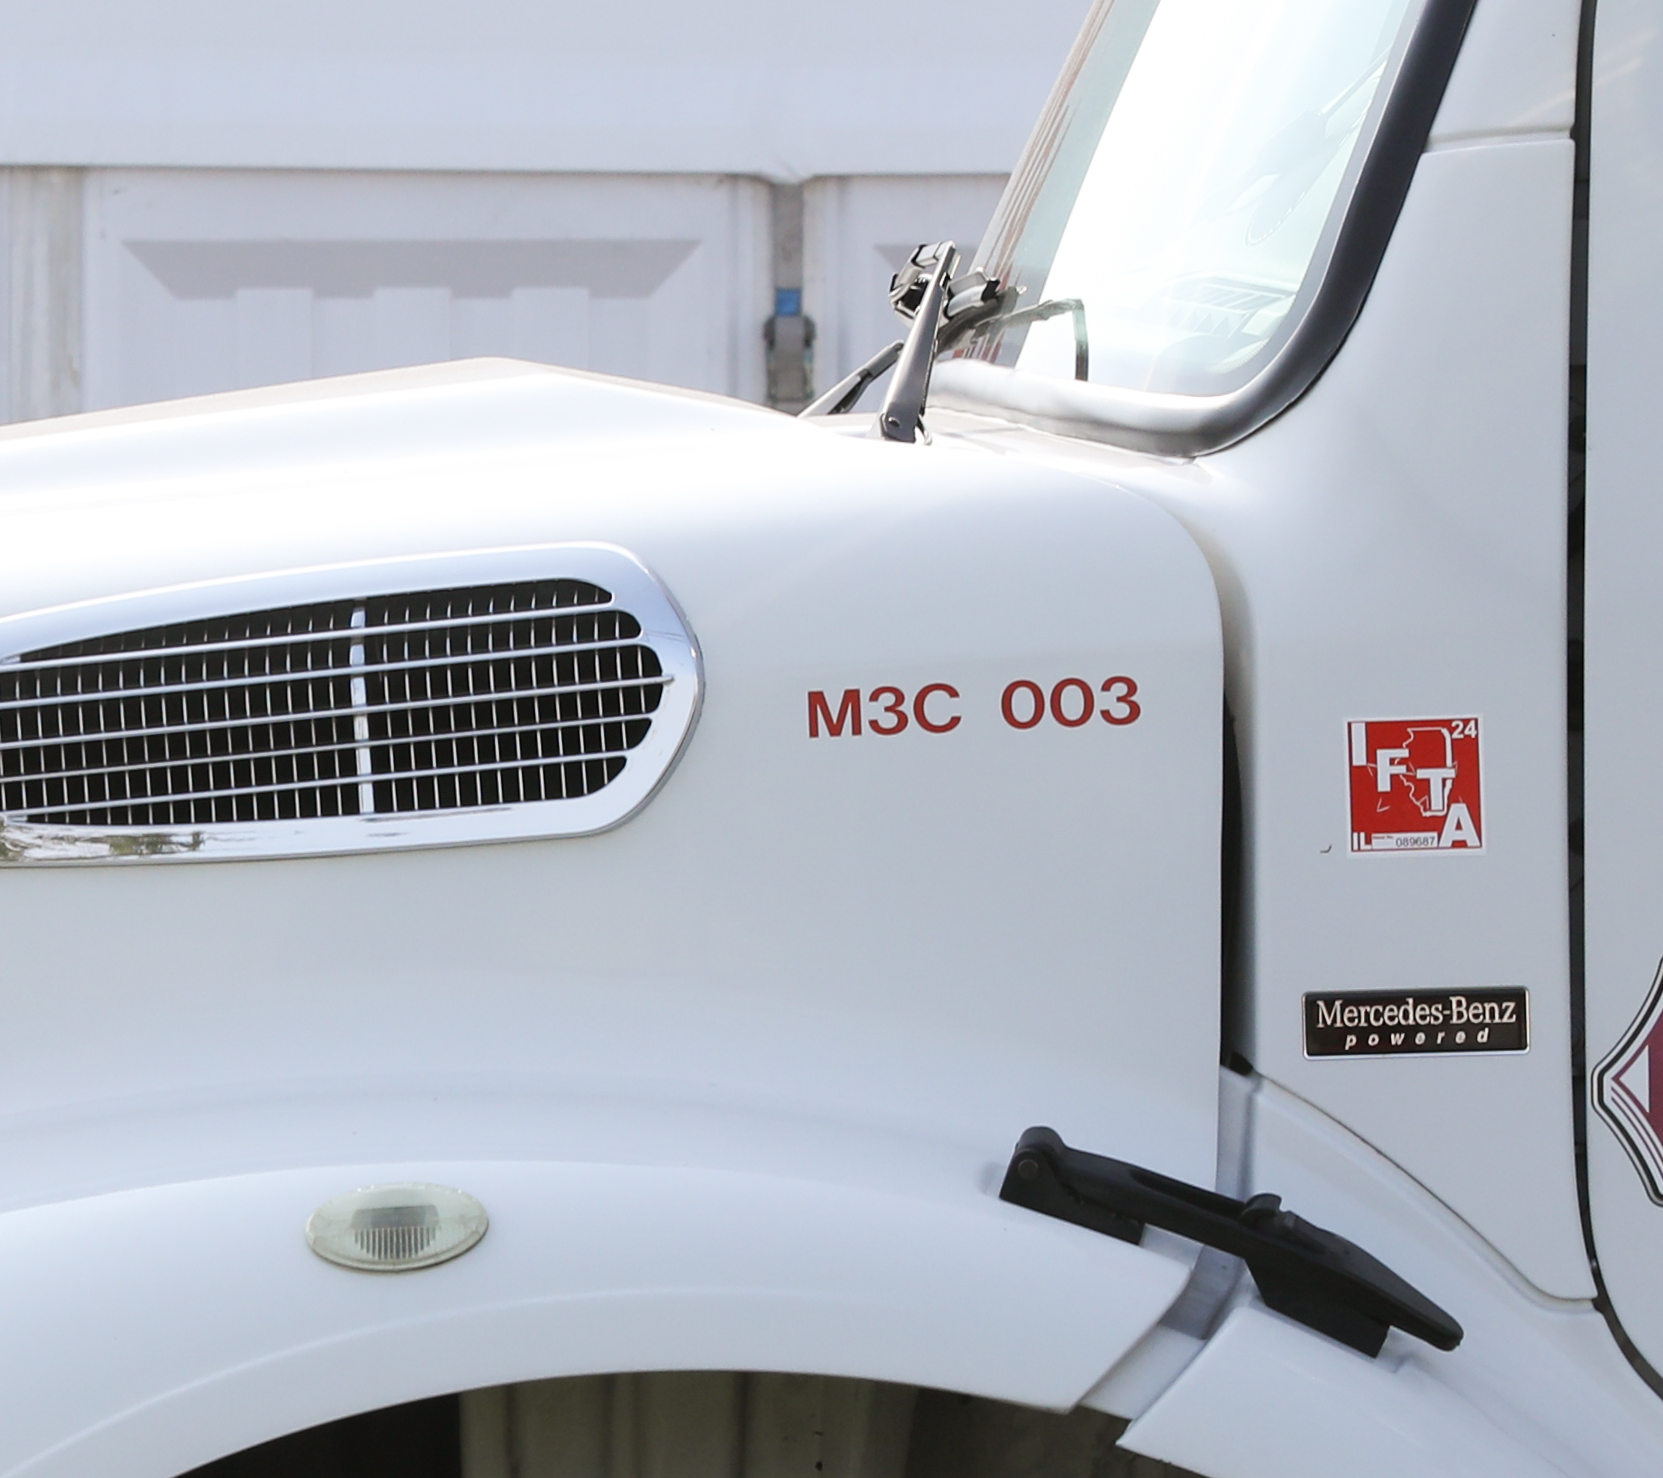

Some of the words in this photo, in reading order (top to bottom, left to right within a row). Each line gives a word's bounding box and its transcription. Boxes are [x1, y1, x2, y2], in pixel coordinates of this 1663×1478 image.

[810, 684, 960, 736] M3C
[1004, 677, 1140, 728] 003
[1451, 720, 1477, 739] 24
[1352, 832, 1372, 850] IL
[1395, 836, 1436, 847] 089687
[1316, 996, 1516, 1028] Mercedes-Benz
[1345, 1028, 1489, 1050] powered
